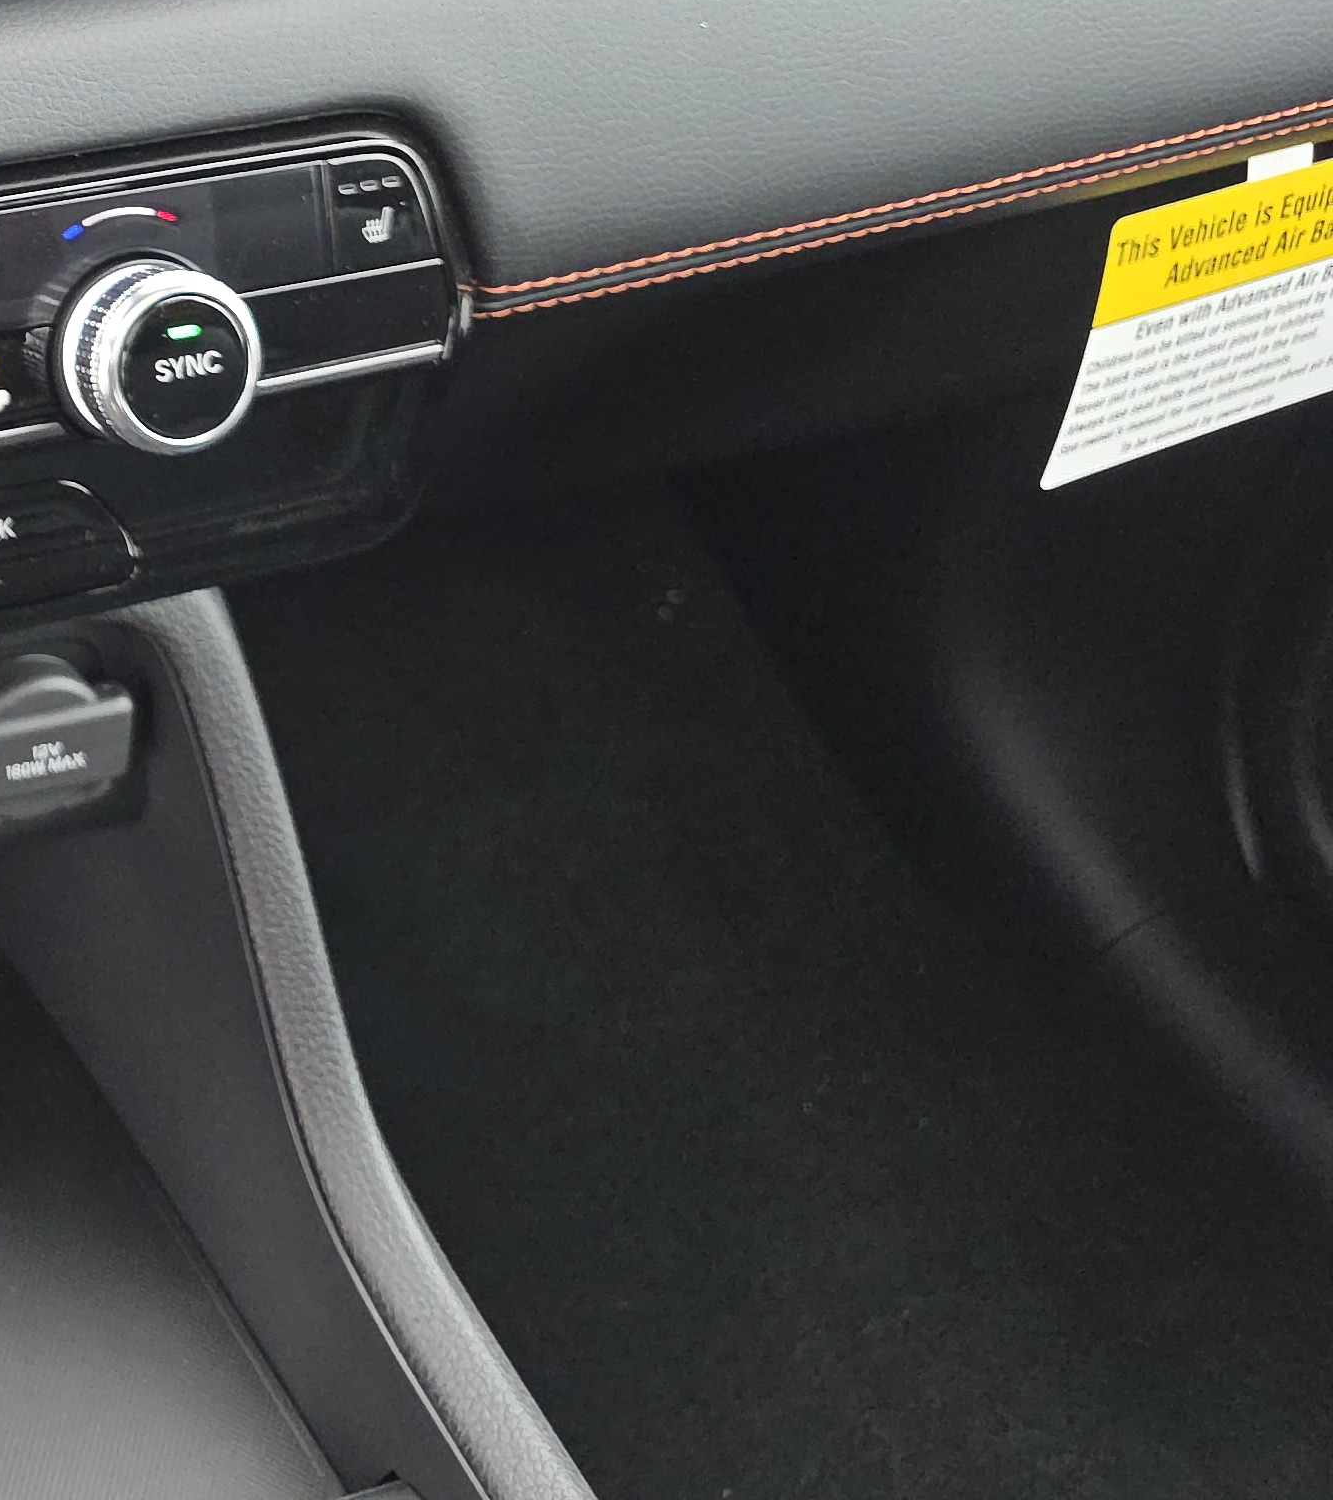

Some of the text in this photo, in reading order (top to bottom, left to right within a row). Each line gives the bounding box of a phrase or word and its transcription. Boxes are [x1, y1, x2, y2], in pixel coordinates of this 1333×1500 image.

[1117, 232, 1161, 267] This
[1170, 209, 1248, 251] Vehicle
[1254, 201, 1274, 228] is
[1164, 234, 1271, 288] Advanced
[1273, 226, 1306, 257] Air
[1134, 316, 1175, 341] Even
[1178, 303, 1213, 326] with
[1215, 276, 1294, 314] Advanced
[1294, 270, 1319, 293] Air
[154, 349, 224, 383] SYNC
